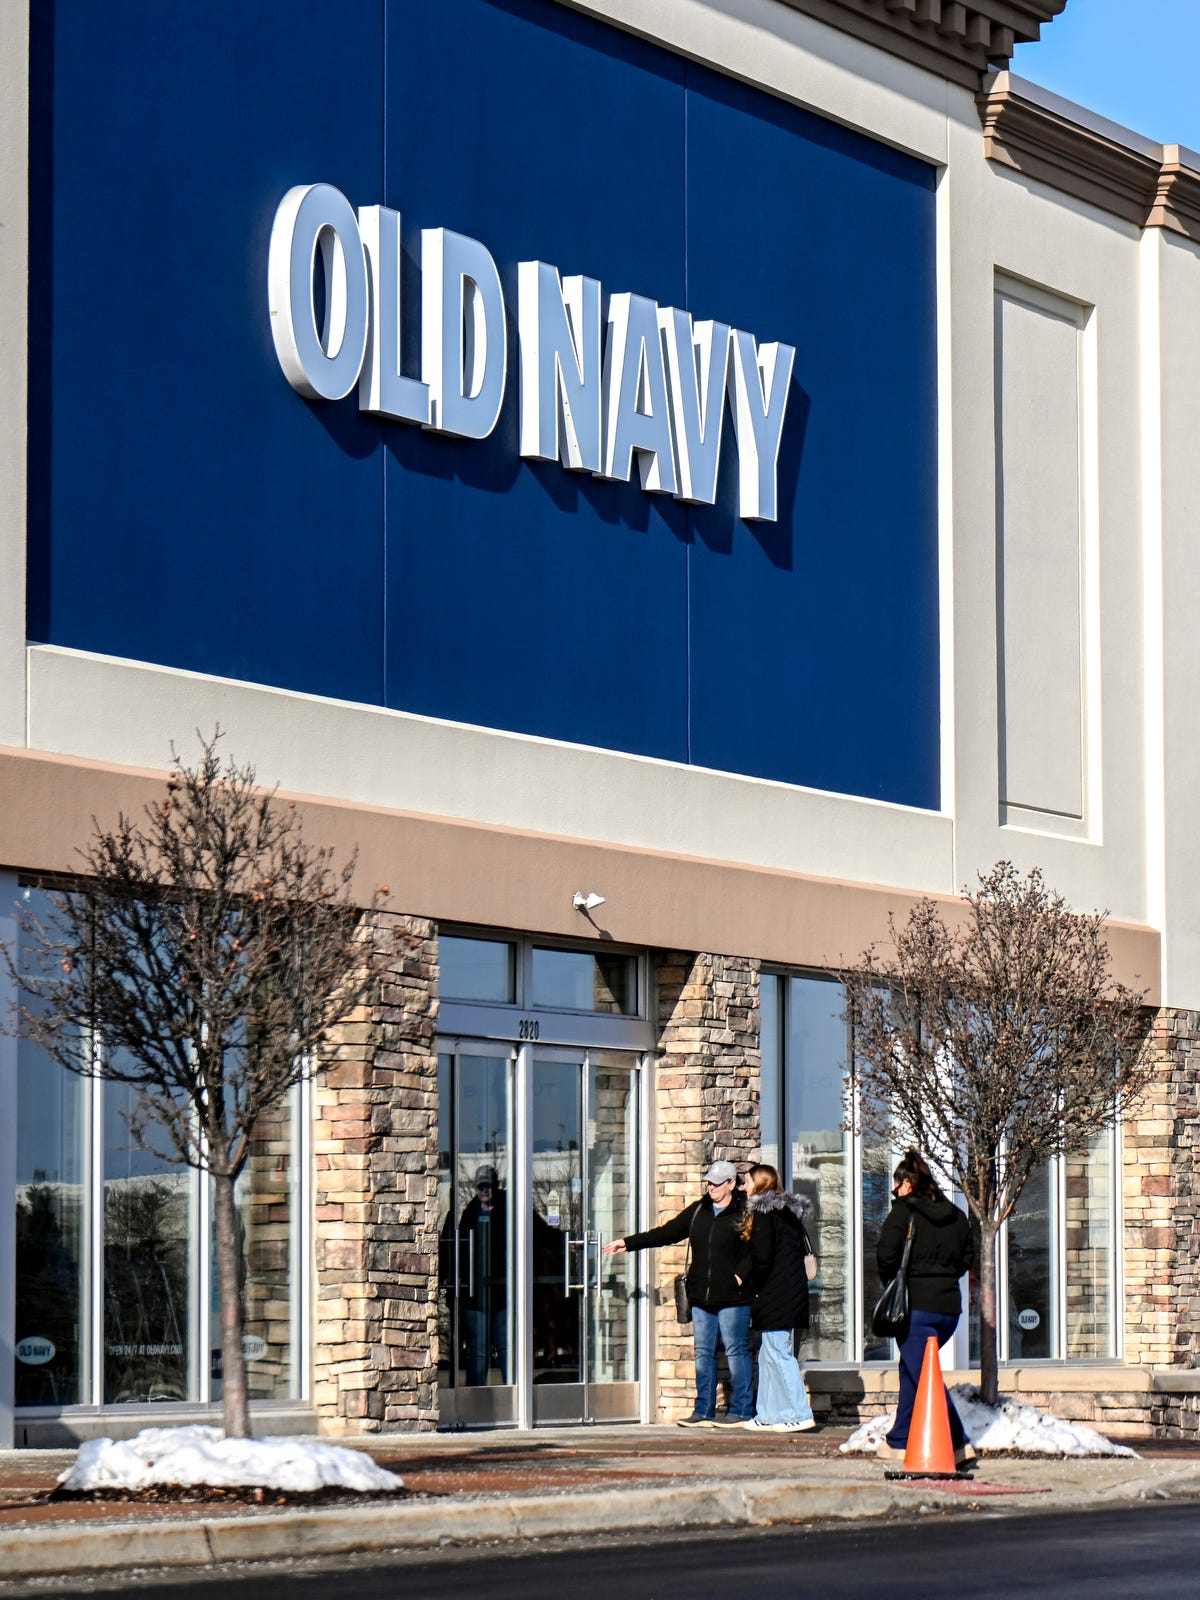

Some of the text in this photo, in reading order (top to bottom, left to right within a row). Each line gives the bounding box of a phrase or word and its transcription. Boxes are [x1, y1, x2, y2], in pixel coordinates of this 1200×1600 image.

[268, 183, 797, 522] OLD NAVY
[519, 1020, 540, 1040] 2820
[19, 1345, 51, 1357] OLD NAVY
[138, 1344, 145, 1355] AT
